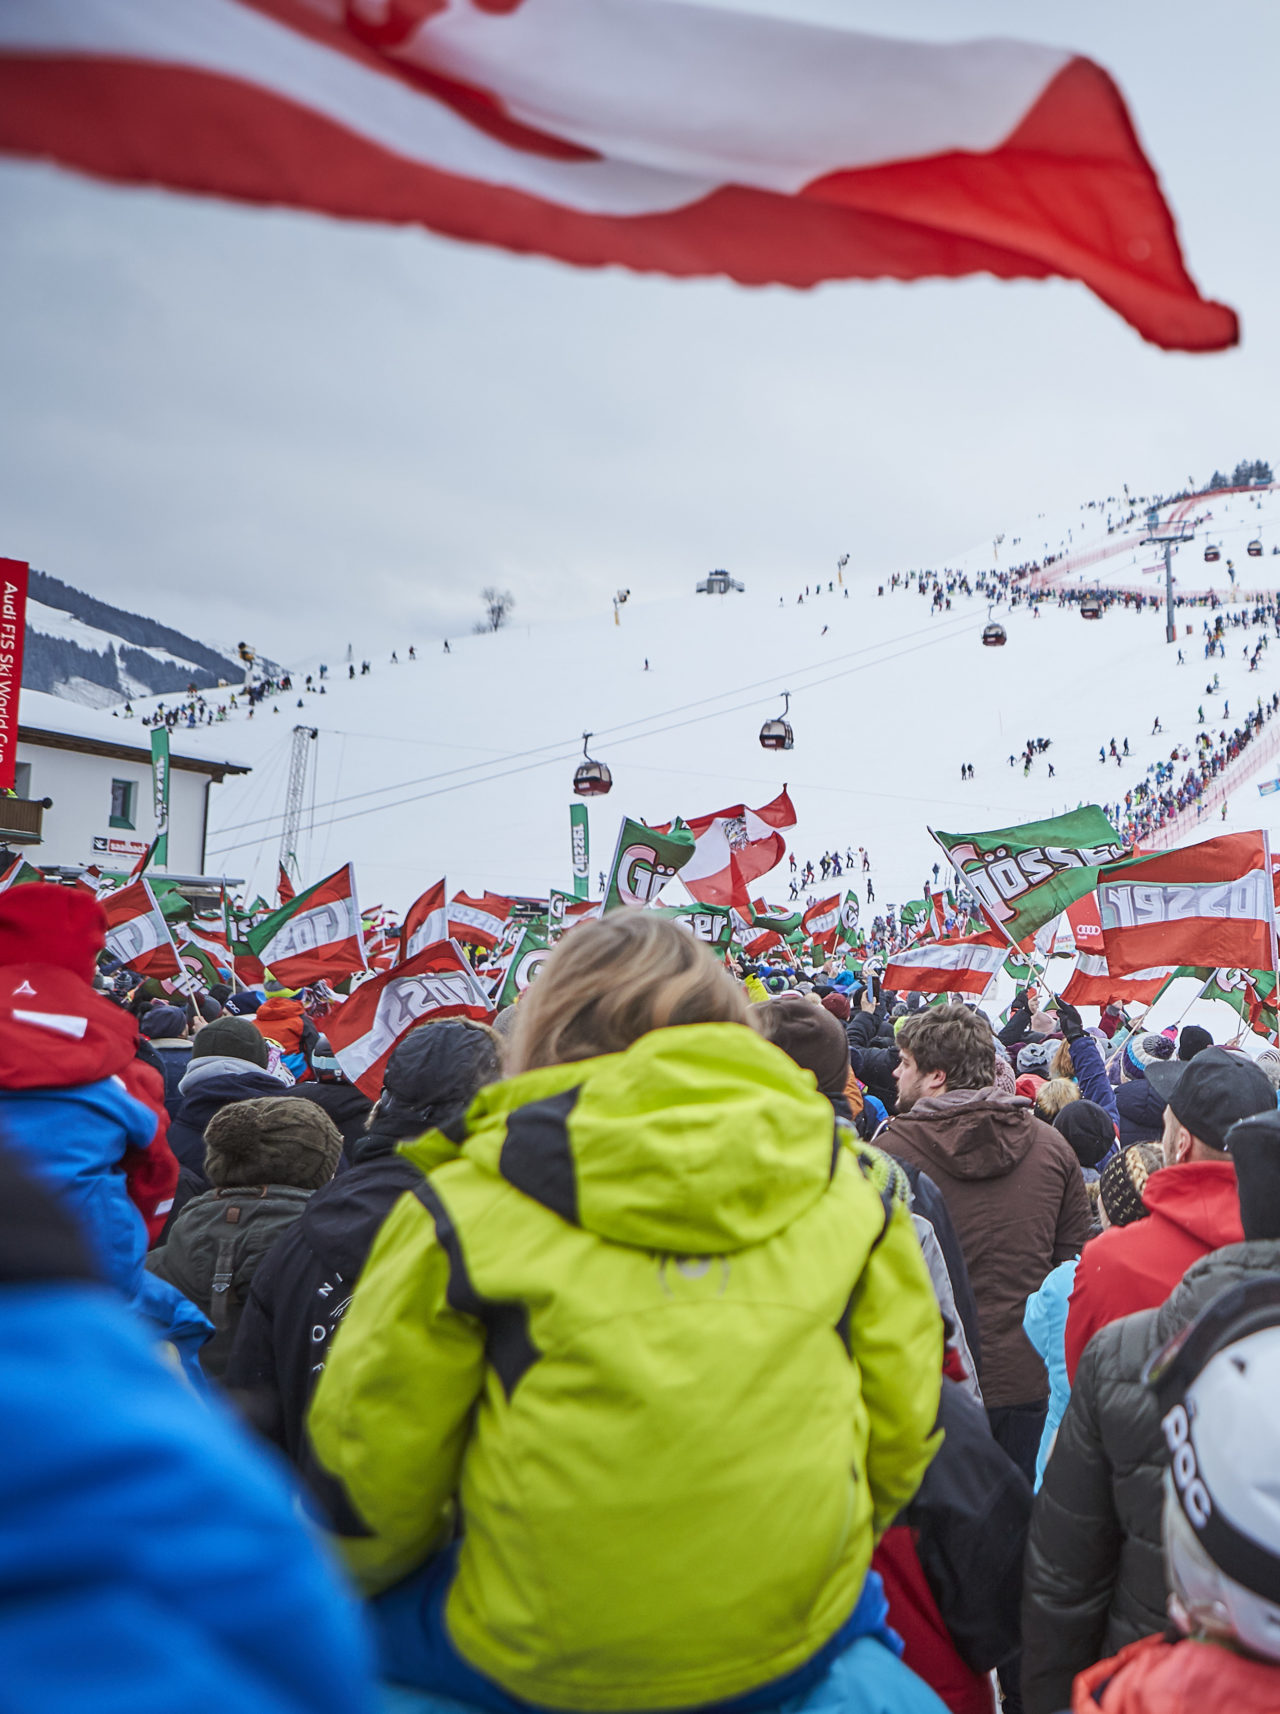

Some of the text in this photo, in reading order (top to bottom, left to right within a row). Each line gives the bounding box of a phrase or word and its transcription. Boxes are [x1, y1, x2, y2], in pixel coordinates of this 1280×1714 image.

[3, 581, 18, 620] Audi
[1, 623, 16, 649] FIS
[0, 651, 14, 677] Ski
[1161, 1404, 1212, 1528] POC
